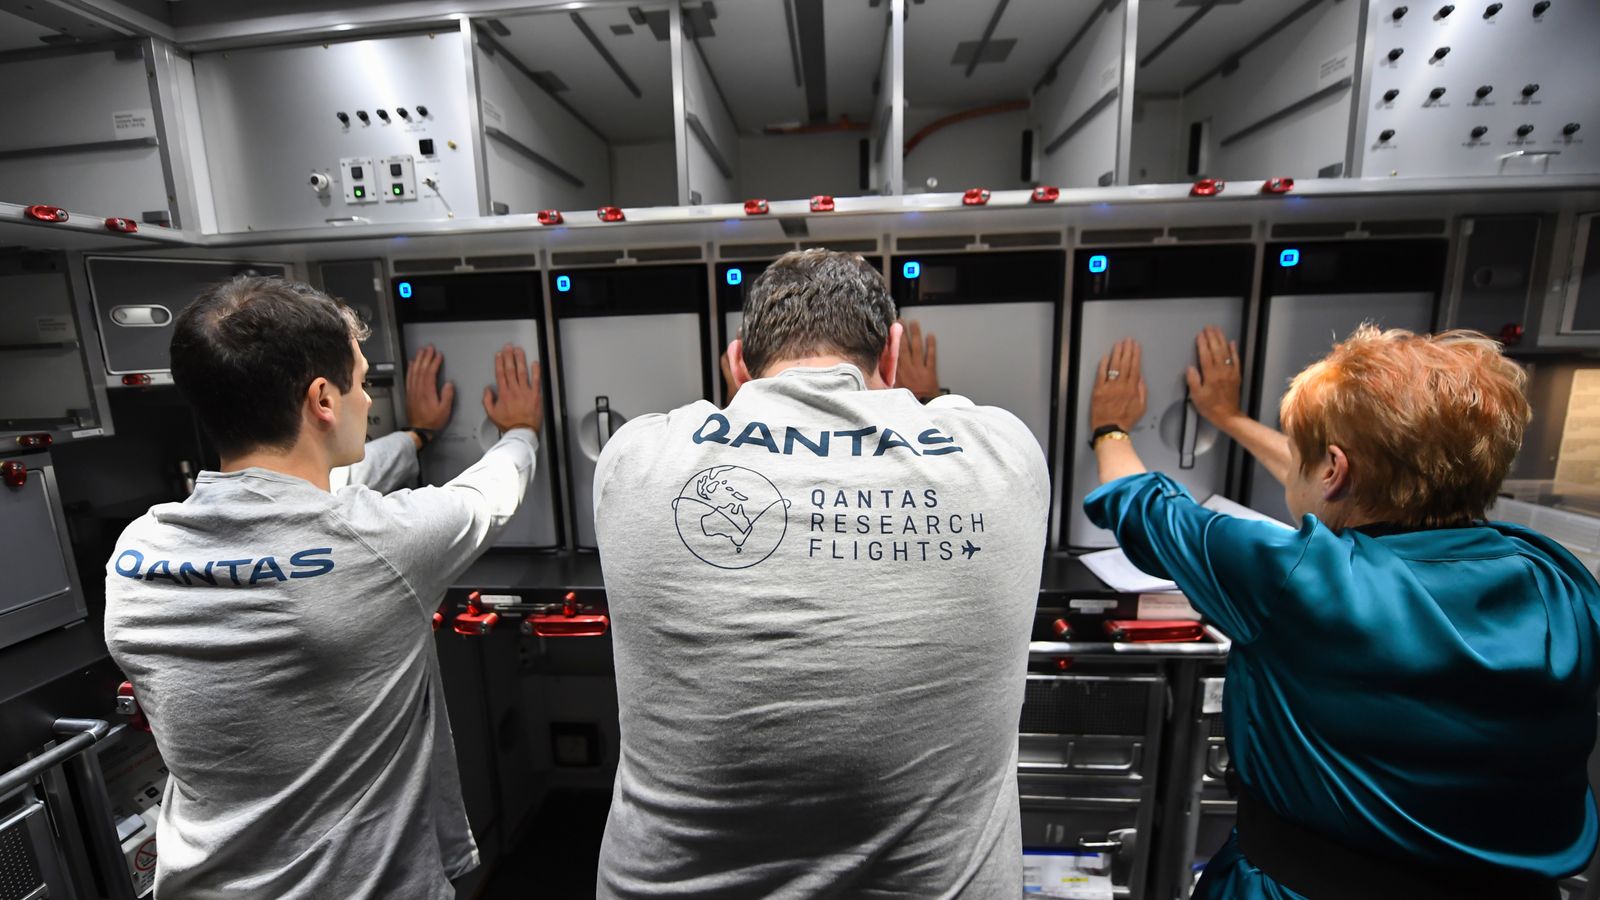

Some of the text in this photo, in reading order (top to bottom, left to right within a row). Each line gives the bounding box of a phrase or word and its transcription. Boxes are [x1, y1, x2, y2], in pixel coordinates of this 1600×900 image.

[692, 413, 963, 457] QANTAS
[811, 489, 938, 509] QANTAS
[810, 513, 985, 534] RESEARCH
[809, 538, 953, 562] FLIGHTS
[115, 548, 335, 586] QANTAS
